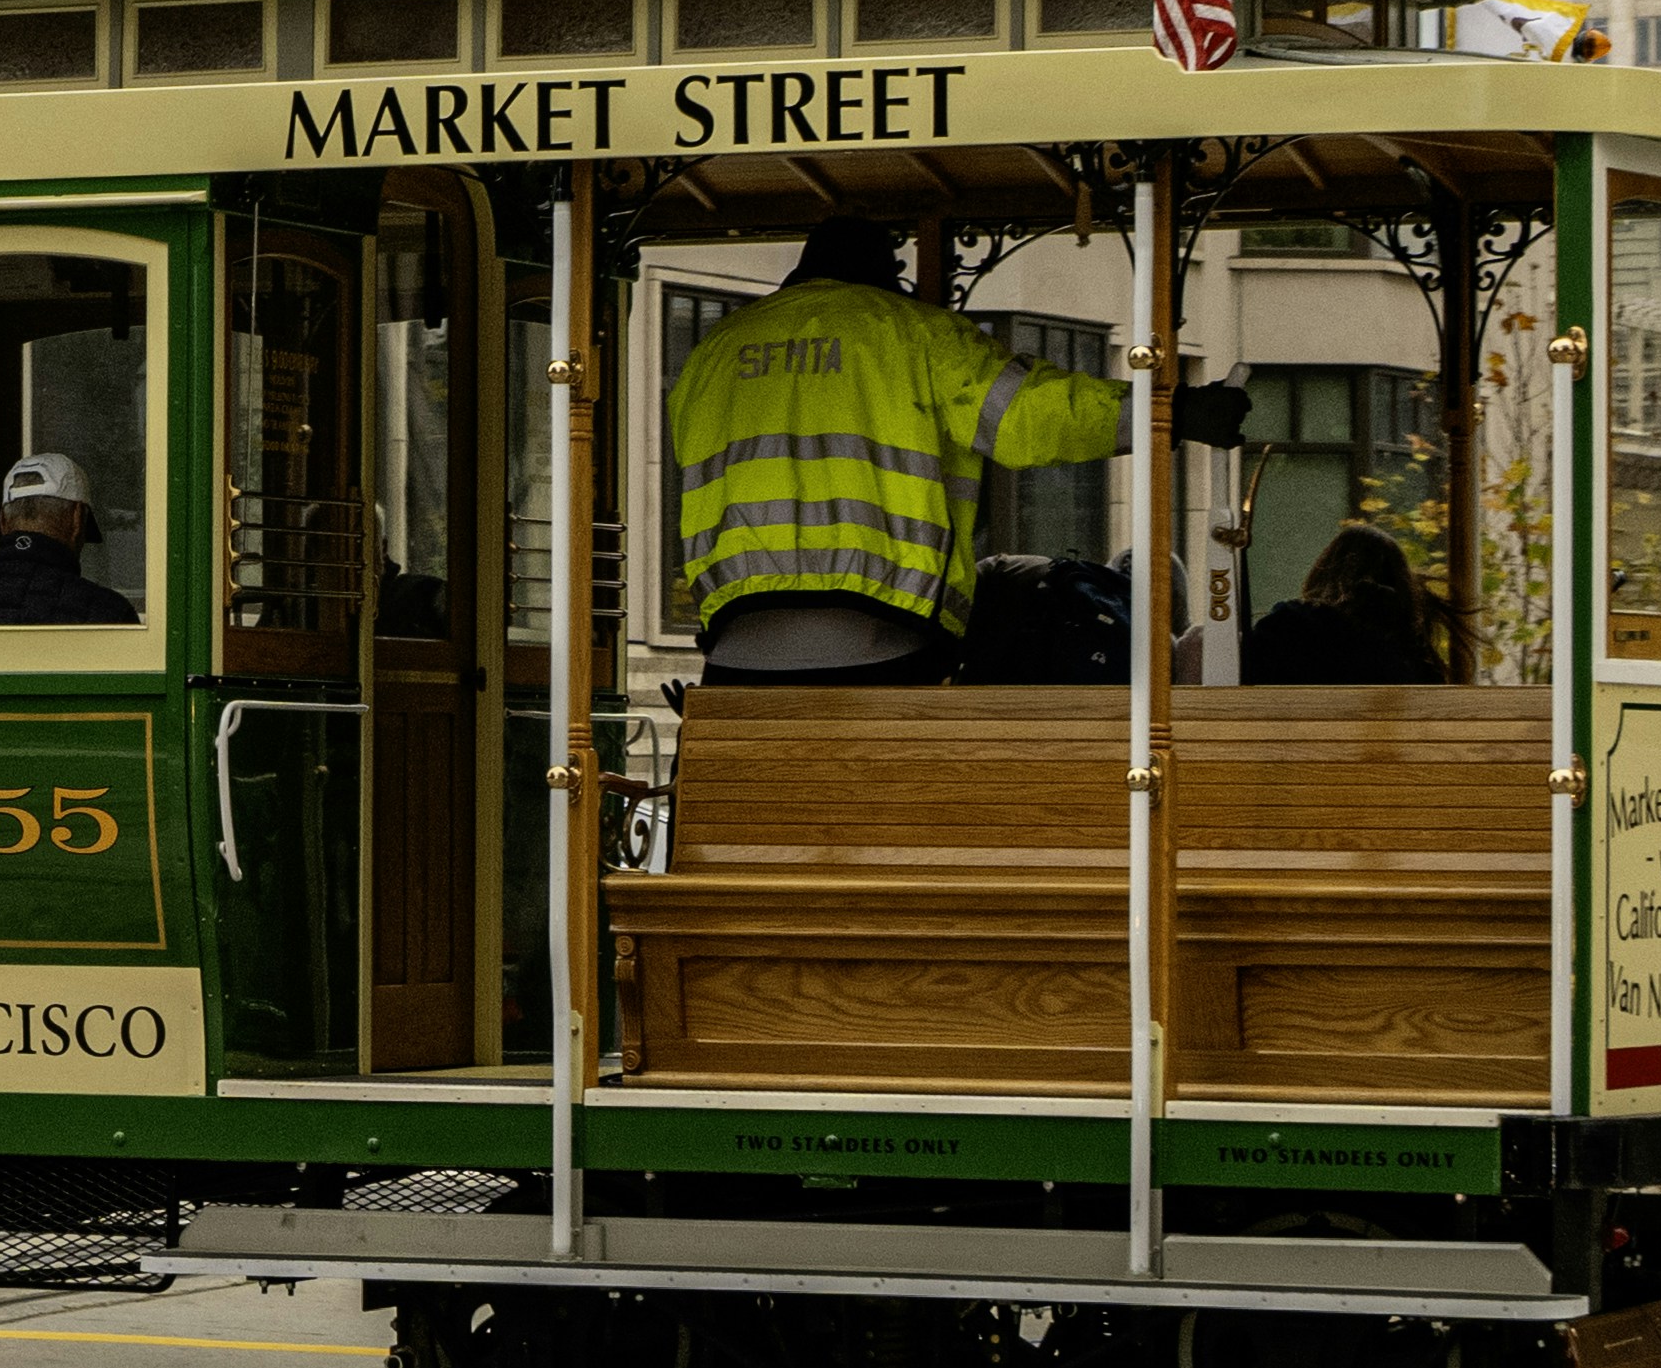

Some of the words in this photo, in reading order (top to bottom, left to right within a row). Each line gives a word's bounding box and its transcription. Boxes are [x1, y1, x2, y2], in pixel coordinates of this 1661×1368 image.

[284, 79, 626, 160] MARKET
[674, 66, 965, 147] STREET
[739, 338, 842, 379] SFMTA
[1608, 959, 1641, 1017] Van
[735, 1135, 783, 1150] TWO
[791, 1136, 895, 1154] STANDEES
[904, 1139, 960, 1154] ONLY
[1218, 1147, 1268, 1163] TWO
[1278, 1149, 1387, 1167] STANDEES
[1398, 1151, 1456, 1168] ONLY
